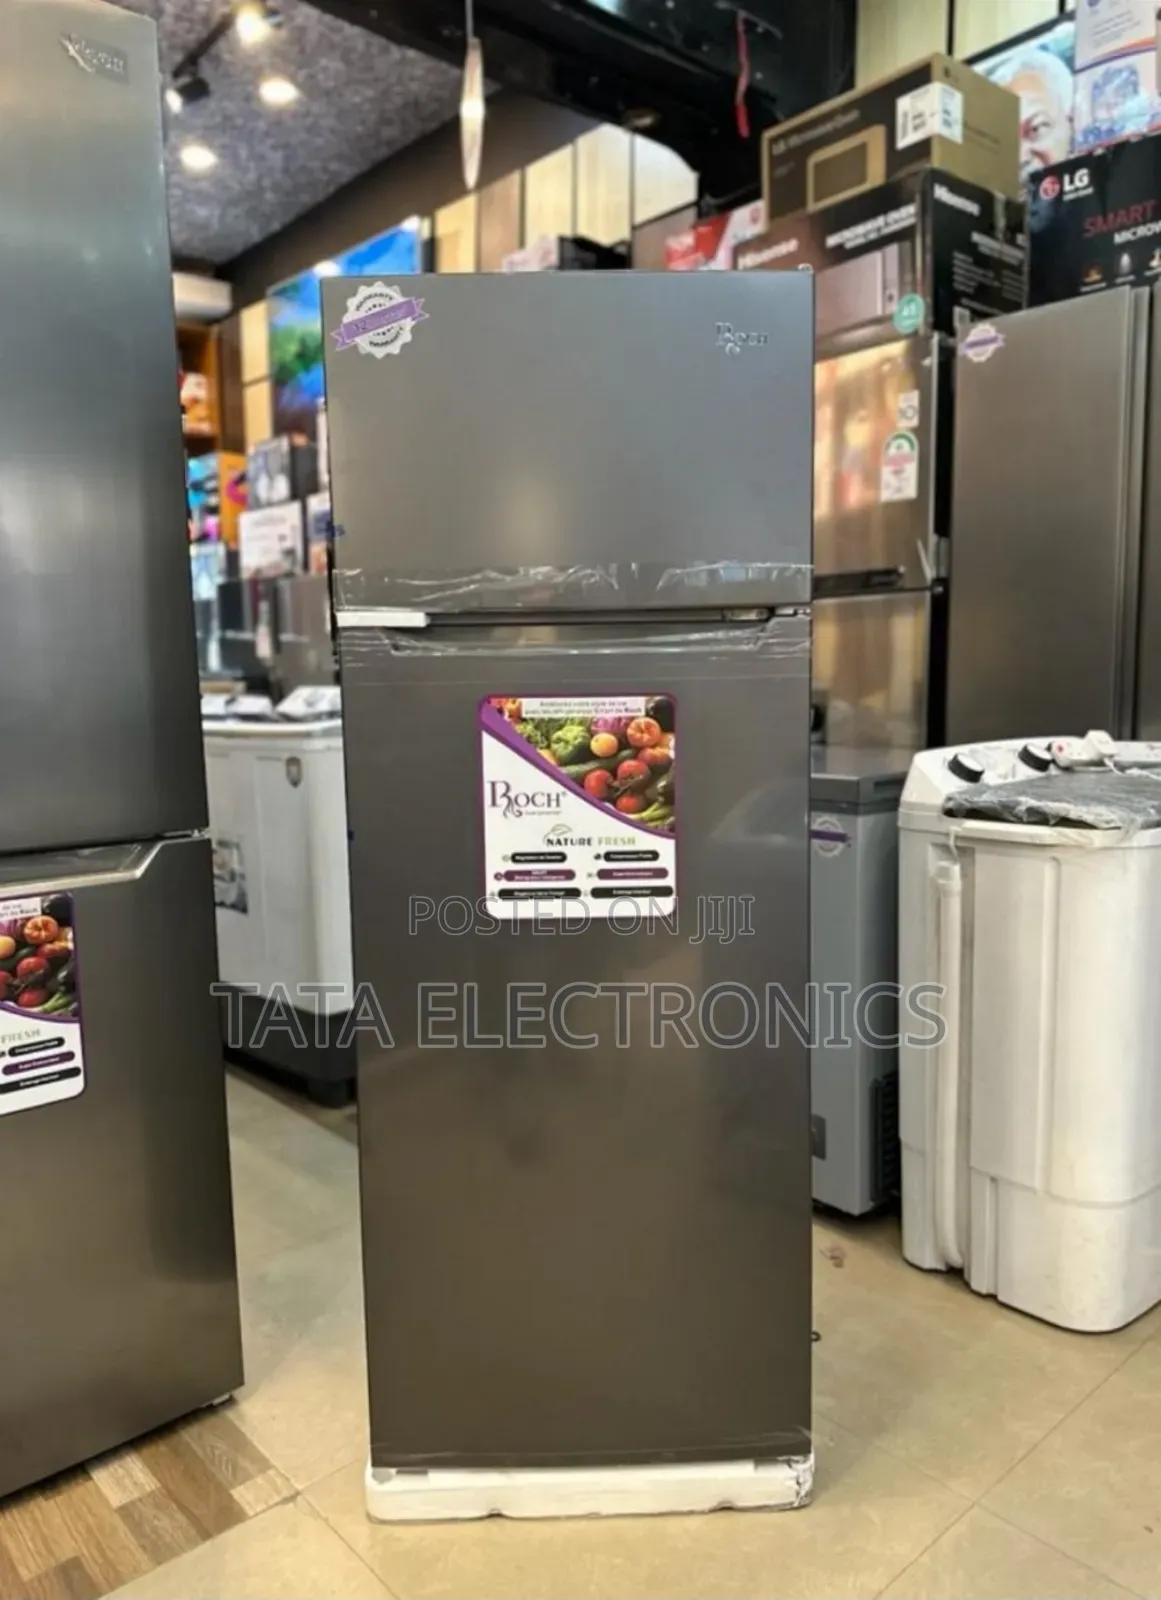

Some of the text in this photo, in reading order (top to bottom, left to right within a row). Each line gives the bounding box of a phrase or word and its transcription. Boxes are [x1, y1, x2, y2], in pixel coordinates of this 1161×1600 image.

[1063, 168, 1090, 191] LG
[1082, 199, 1156, 238] SMART
[487, 780, 562, 819] ROCH
[545, 836, 636, 847] NATURE FRESH
